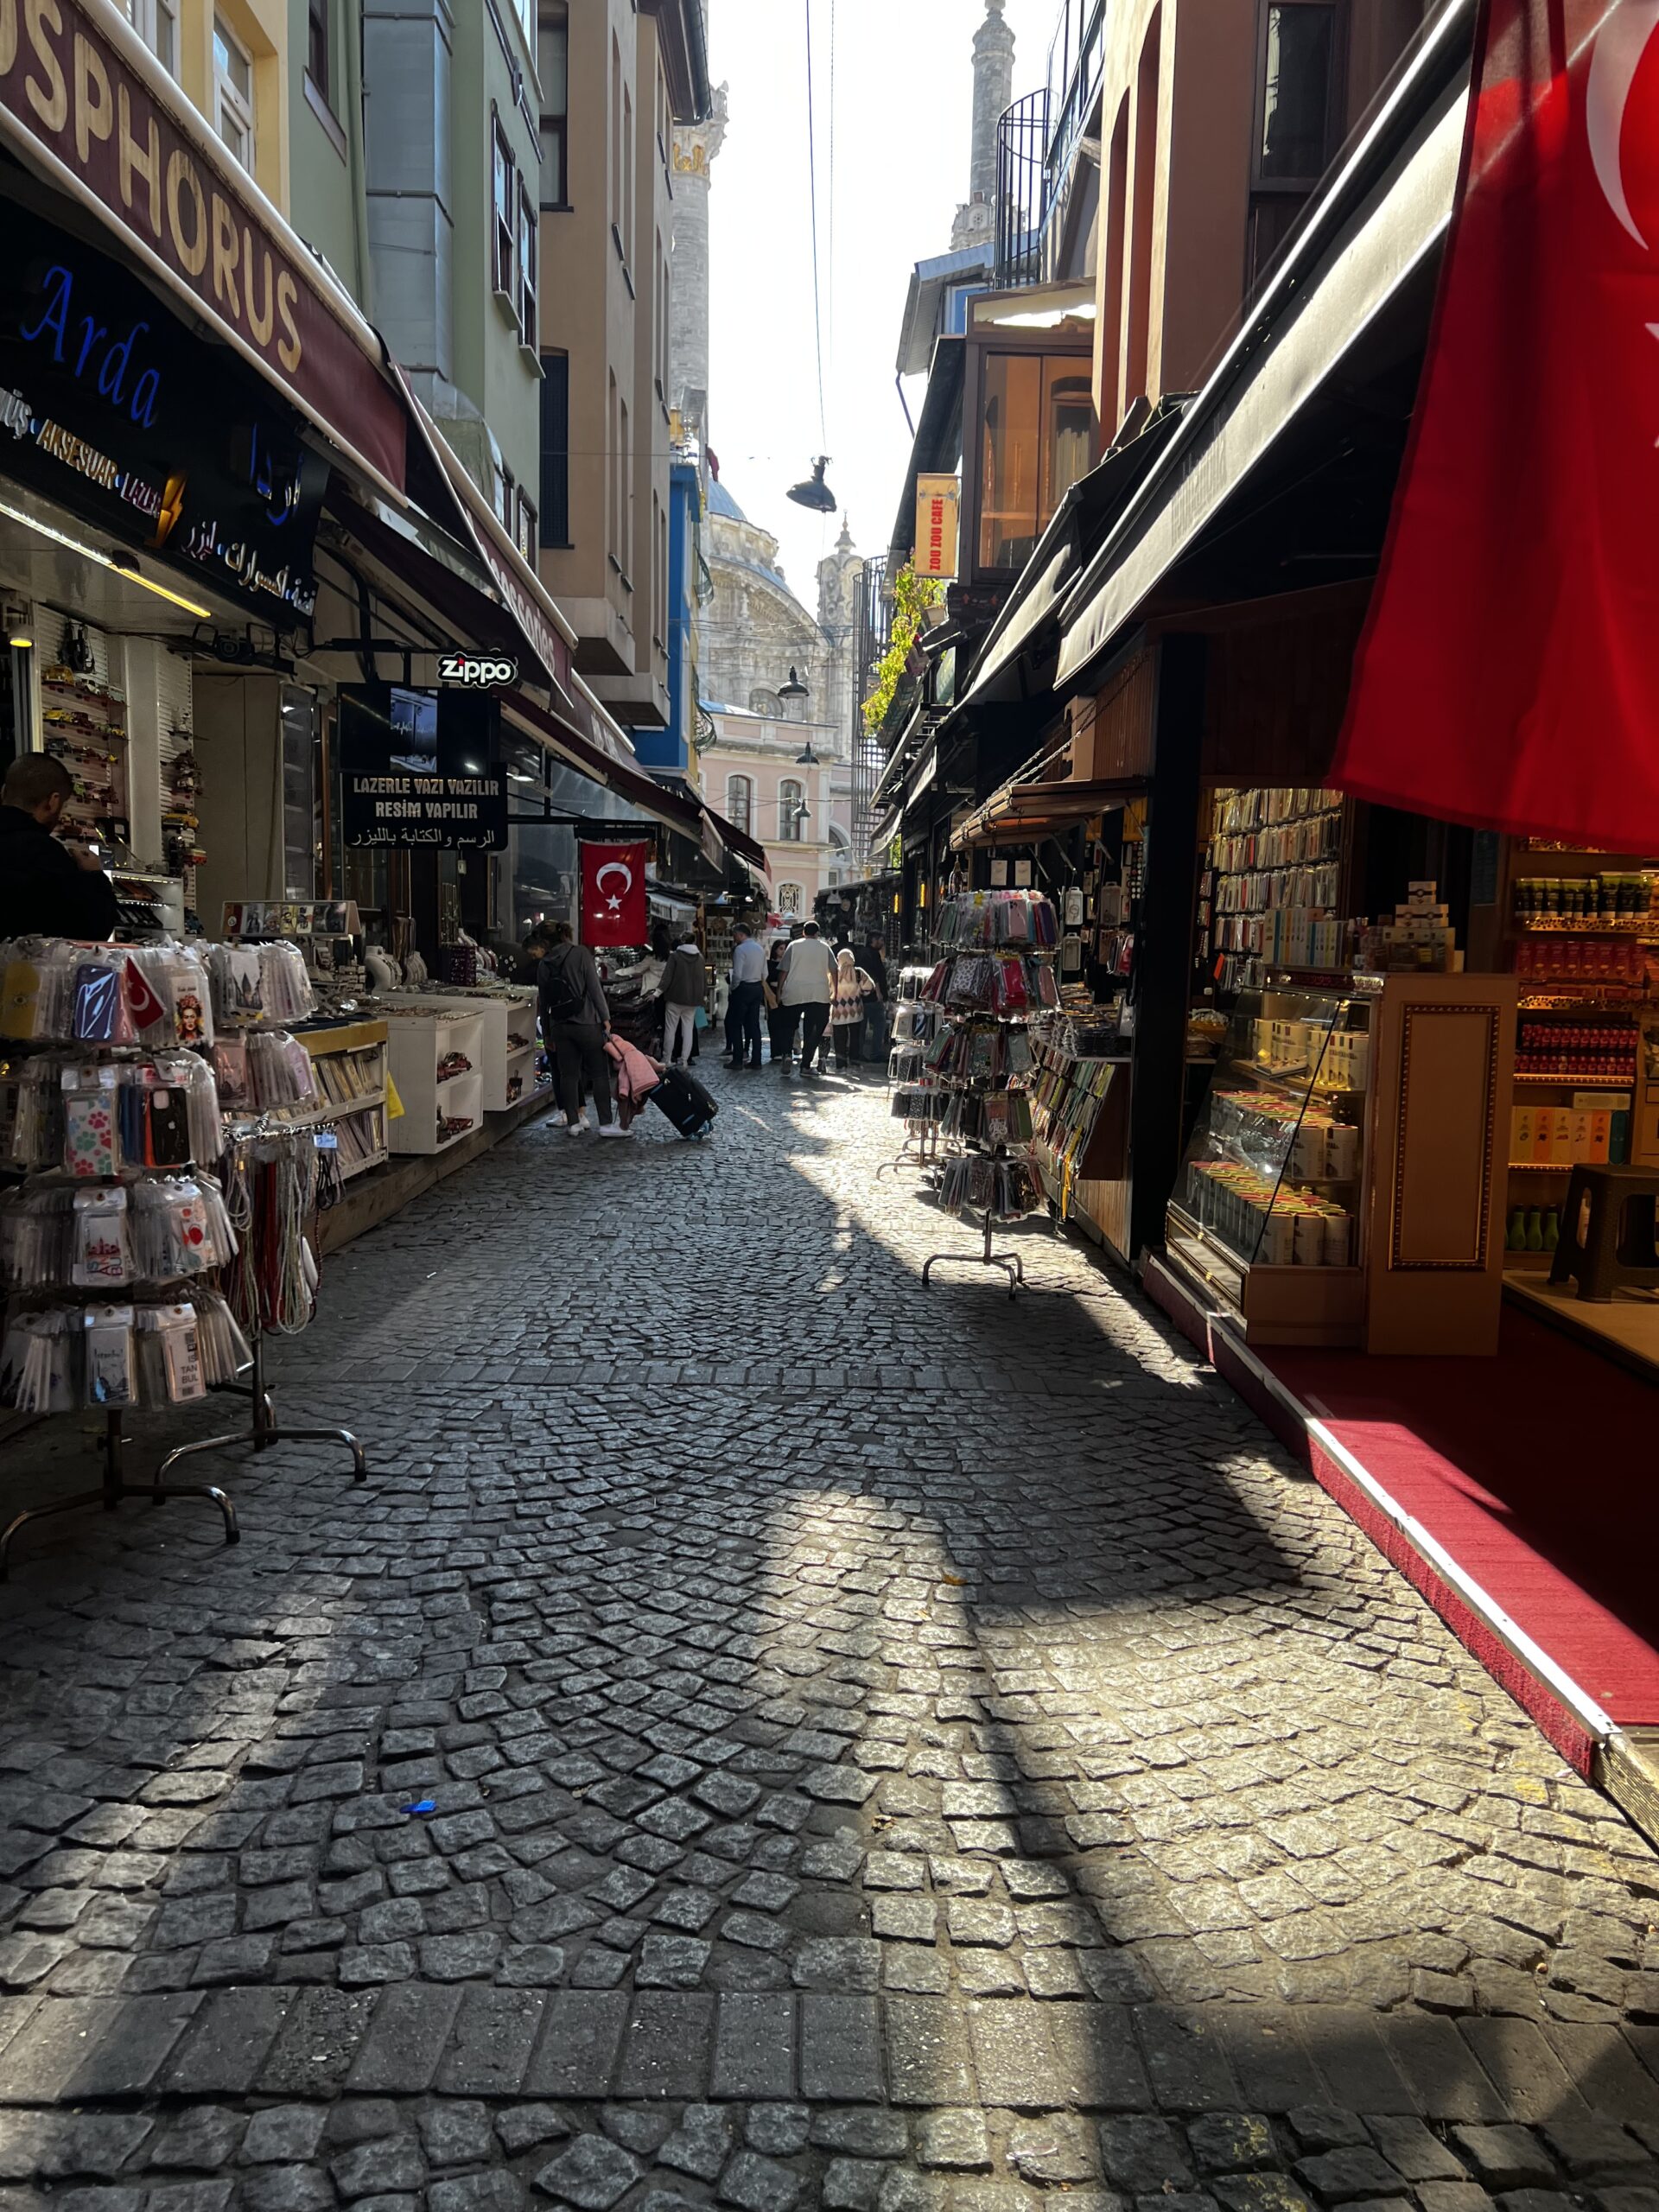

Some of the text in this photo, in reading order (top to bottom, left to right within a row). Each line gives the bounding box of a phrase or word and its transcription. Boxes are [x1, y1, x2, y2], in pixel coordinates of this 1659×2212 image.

[19, 265, 161, 429] Arda
[36, 418, 118, 490] AKSESUAR
[929, 499, 944, 571] ZOU ZOU CAFE
[353, 778, 499, 796] LAZERLE YAZI YAZILIR
[375, 799, 478, 819] RESİM YAPILIR
[181, 1364, 198, 1374] TAN
[181, 1375, 198, 1384] BUL
